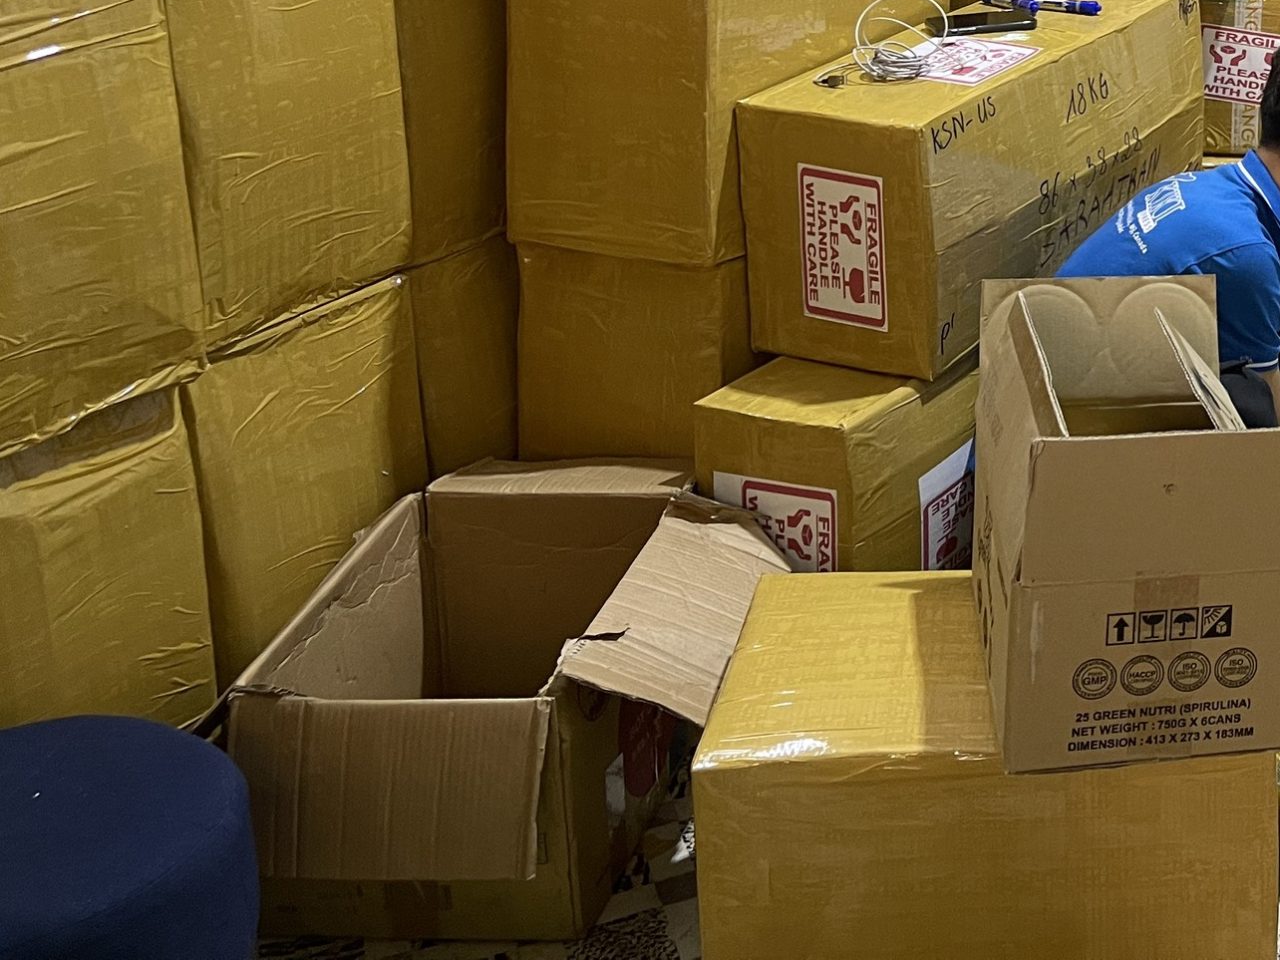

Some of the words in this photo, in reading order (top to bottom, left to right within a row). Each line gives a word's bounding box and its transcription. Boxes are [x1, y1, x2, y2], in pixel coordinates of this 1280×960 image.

[1215, 31, 1278, 49] FRAGIL
[1214, 76, 1264, 90] HAND
[1216, 65, 1270, 80] PLEAS
[977, 96, 996, 123] US
[805, 182, 816, 236] WITH
[817, 201, 829, 289] HANDLE
[828, 204, 841, 289] PLEASE
[866, 202, 881, 305] FRAGILE
[807, 243, 819, 302] CARE
[931, 481, 967, 516] CARE
[1083, 676, 1106, 686] GMP
[1076, 713, 1089, 722] 25
[1093, 709, 1136, 721] GREEN
[1140, 706, 1176, 717] NUTRI
[1180, 698, 1251, 715] (SPIRULINA)
[1072, 727, 1096, 737] NET
[1100, 722, 1147, 735] WEIGHT
[1158, 719, 1186, 730] 750G
[1189, 718, 1197, 727] X
[1201, 714, 1241, 726] 6CANS
[1068, 738, 1136, 752] DIMENSION
[1145, 735, 1165, 745] 413
[1169, 735, 1178, 743] X
[1180, 731, 1200, 742] 273
[1204, 730, 1212, 740] X
[1215, 727, 1254, 739] 183MM
